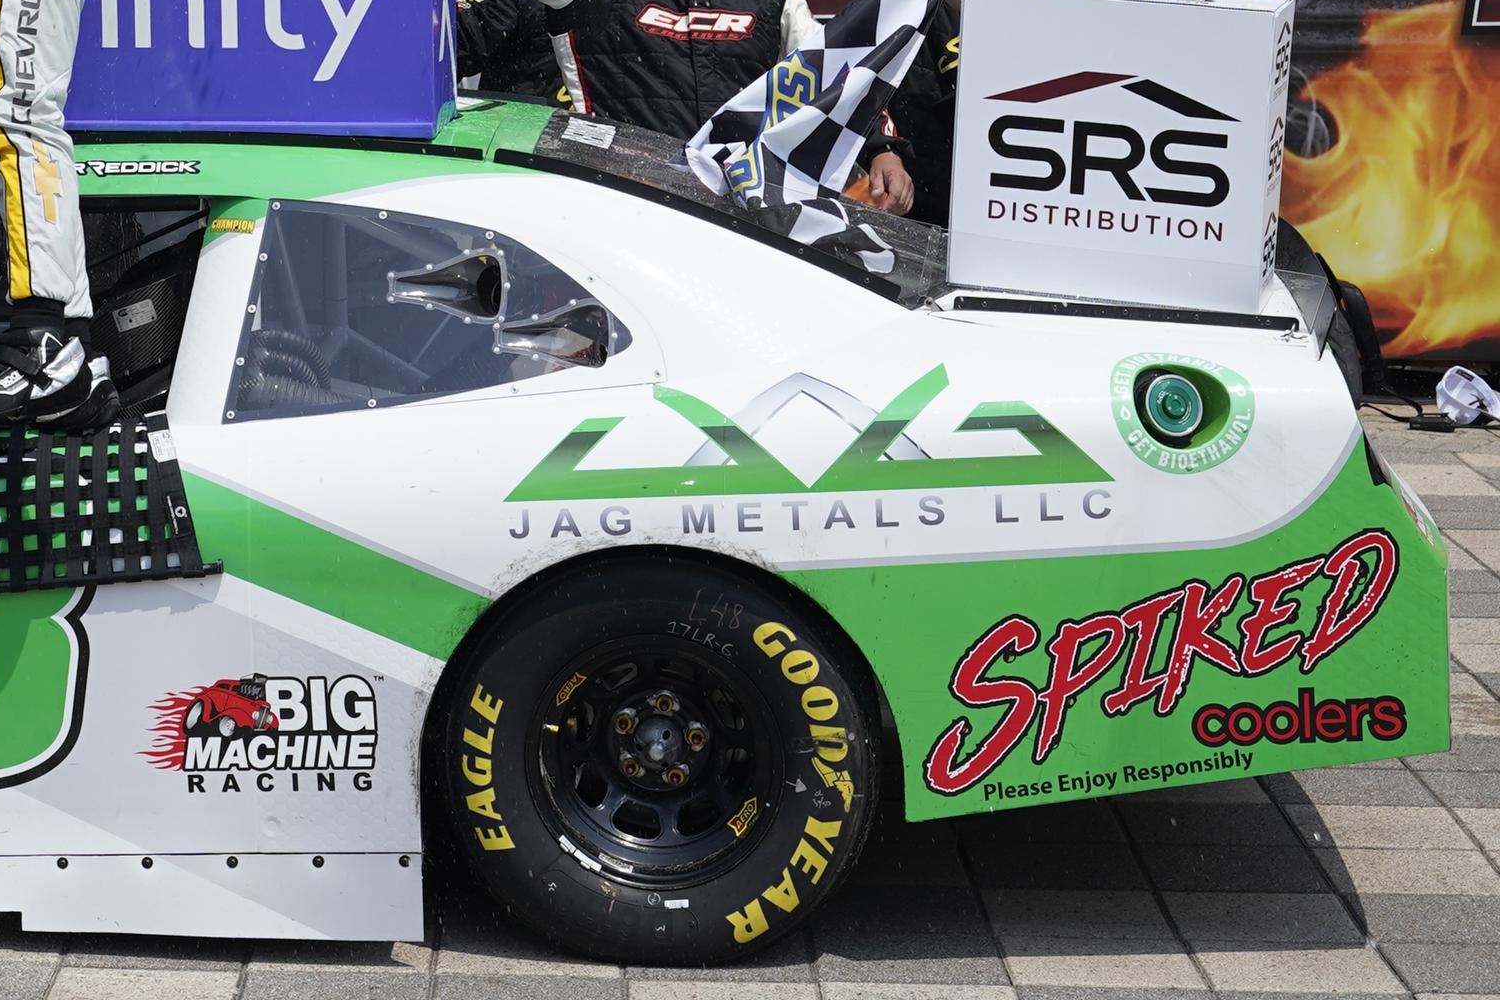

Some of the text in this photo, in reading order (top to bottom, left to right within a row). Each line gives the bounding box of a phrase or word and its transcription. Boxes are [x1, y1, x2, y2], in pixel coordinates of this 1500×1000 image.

[638, 7, 753, 33] ECR
[86, 160, 199, 176] REDDICK
[988, 114, 1230, 208] SRS
[211, 219, 254, 231] CHAMPION
[988, 200, 1224, 242] DISTRIBUTION
[1128, 428, 1157, 459] GET
[510, 489, 1113, 540] JAG METALS LLC
[924, 528, 1400, 797] SPIKED
[269, 675, 378, 735] BIG
[1191, 688, 1408, 747] coolers
[182, 733, 378, 772] MACHINE
[462, 682, 516, 852] EAGLE
[187, 772, 375, 794] RACING
[984, 750, 1254, 802] Please Enjoy Responsibly
